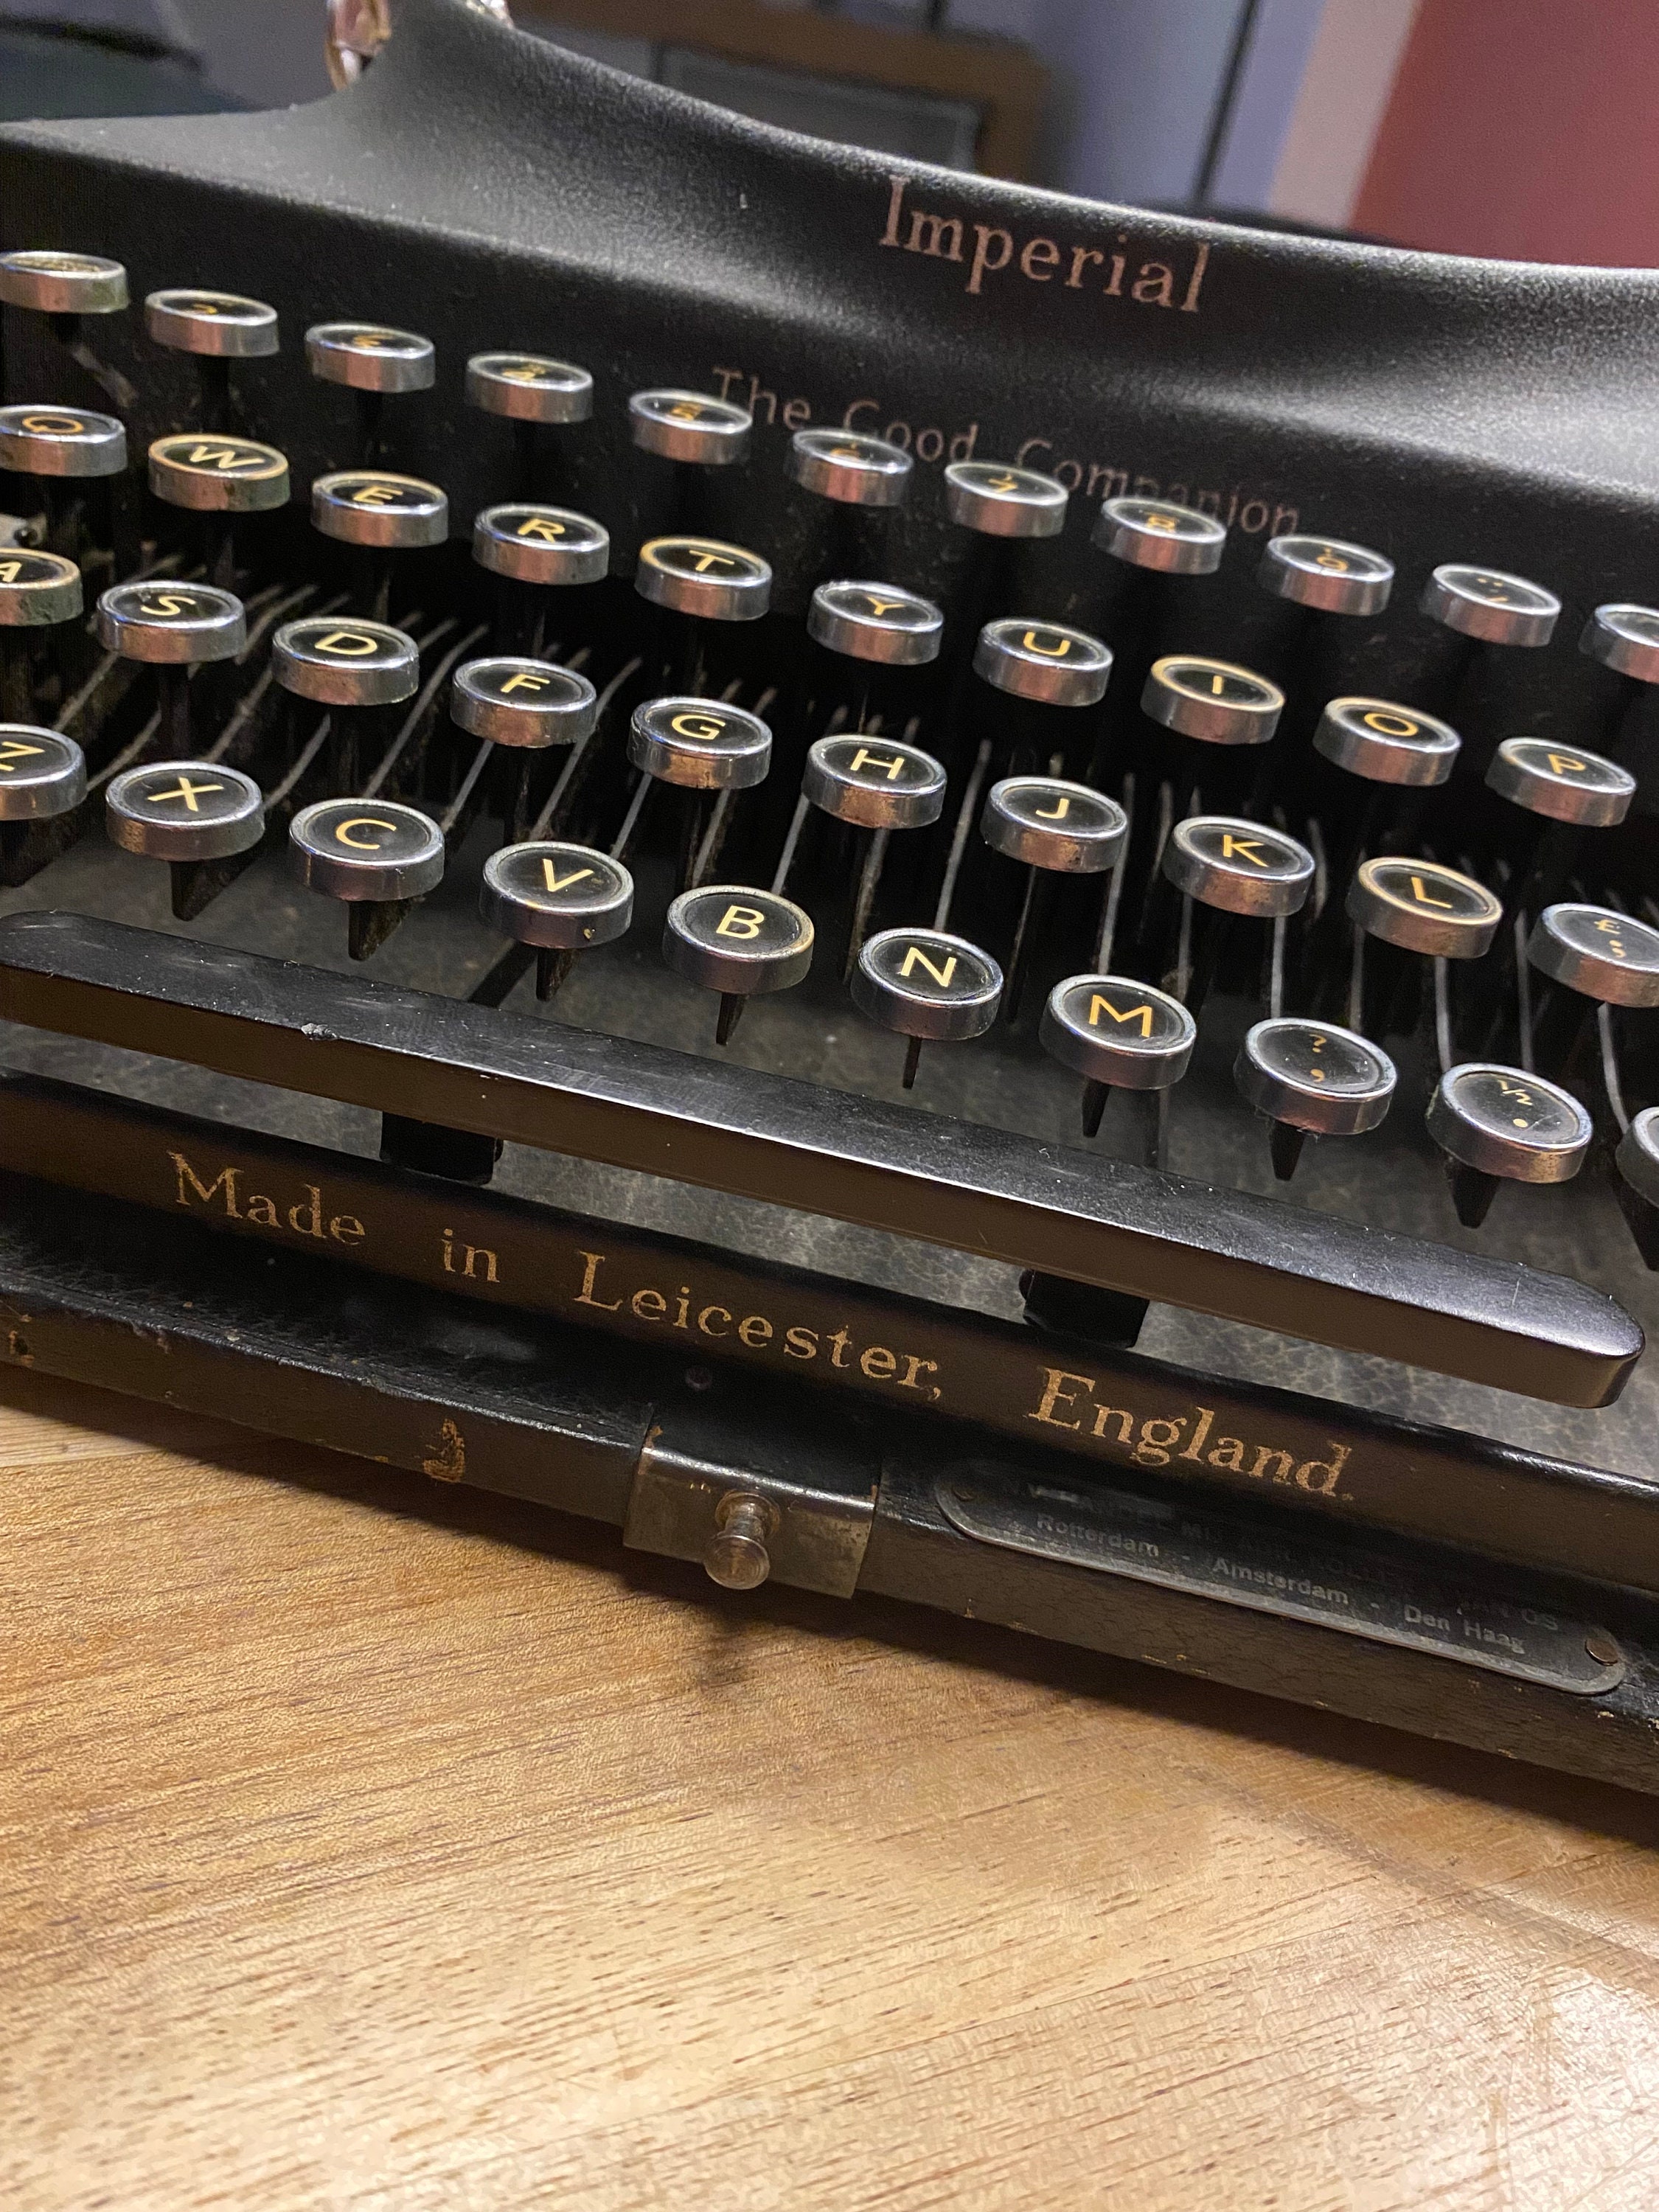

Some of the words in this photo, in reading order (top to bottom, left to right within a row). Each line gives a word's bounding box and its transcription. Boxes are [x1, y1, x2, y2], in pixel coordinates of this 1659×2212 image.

[880, 174, 1210, 313] Imperial
[713, 366, 812, 431] The
[189, 445, 266, 470] W
[352, 485, 404, 505] E
[517, 518, 566, 543] R
[689, 549, 734, 572] T
[141, 596, 196, 616] S
[867, 596, 905, 616] Y
[314, 630, 378, 655] D
[1023, 631, 1071, 656] U
[500, 673, 551, 693] F
[1211, 675, 1223, 695] I
[671, 714, 726, 740] G
[1363, 712, 1419, 737] O
[849, 748, 905, 780] H
[1548, 754, 1587, 774] P
[147, 776, 225, 812] X
[1035, 798, 1070, 820] J
[335, 818, 397, 850] C
[1222, 835, 1268, 867] K
[542, 858, 594, 893] V
[1411, 877, 1453, 908] L
[715, 905, 766, 939] B
[900, 947, 957, 987] N
[1088, 994, 1153, 1038] M
[167, 1150, 367, 1246] Made
[441, 1228, 501, 1284] in
[572, 1250, 942, 1401] Leicester,
[1035, 1513, 1160, 1557] Rotterdam
[1211, 1556, 1349, 1606] Amsterdam
[1403, 1603, 1451, 1632] Den
[1463, 1617, 1526, 1655] Haag
